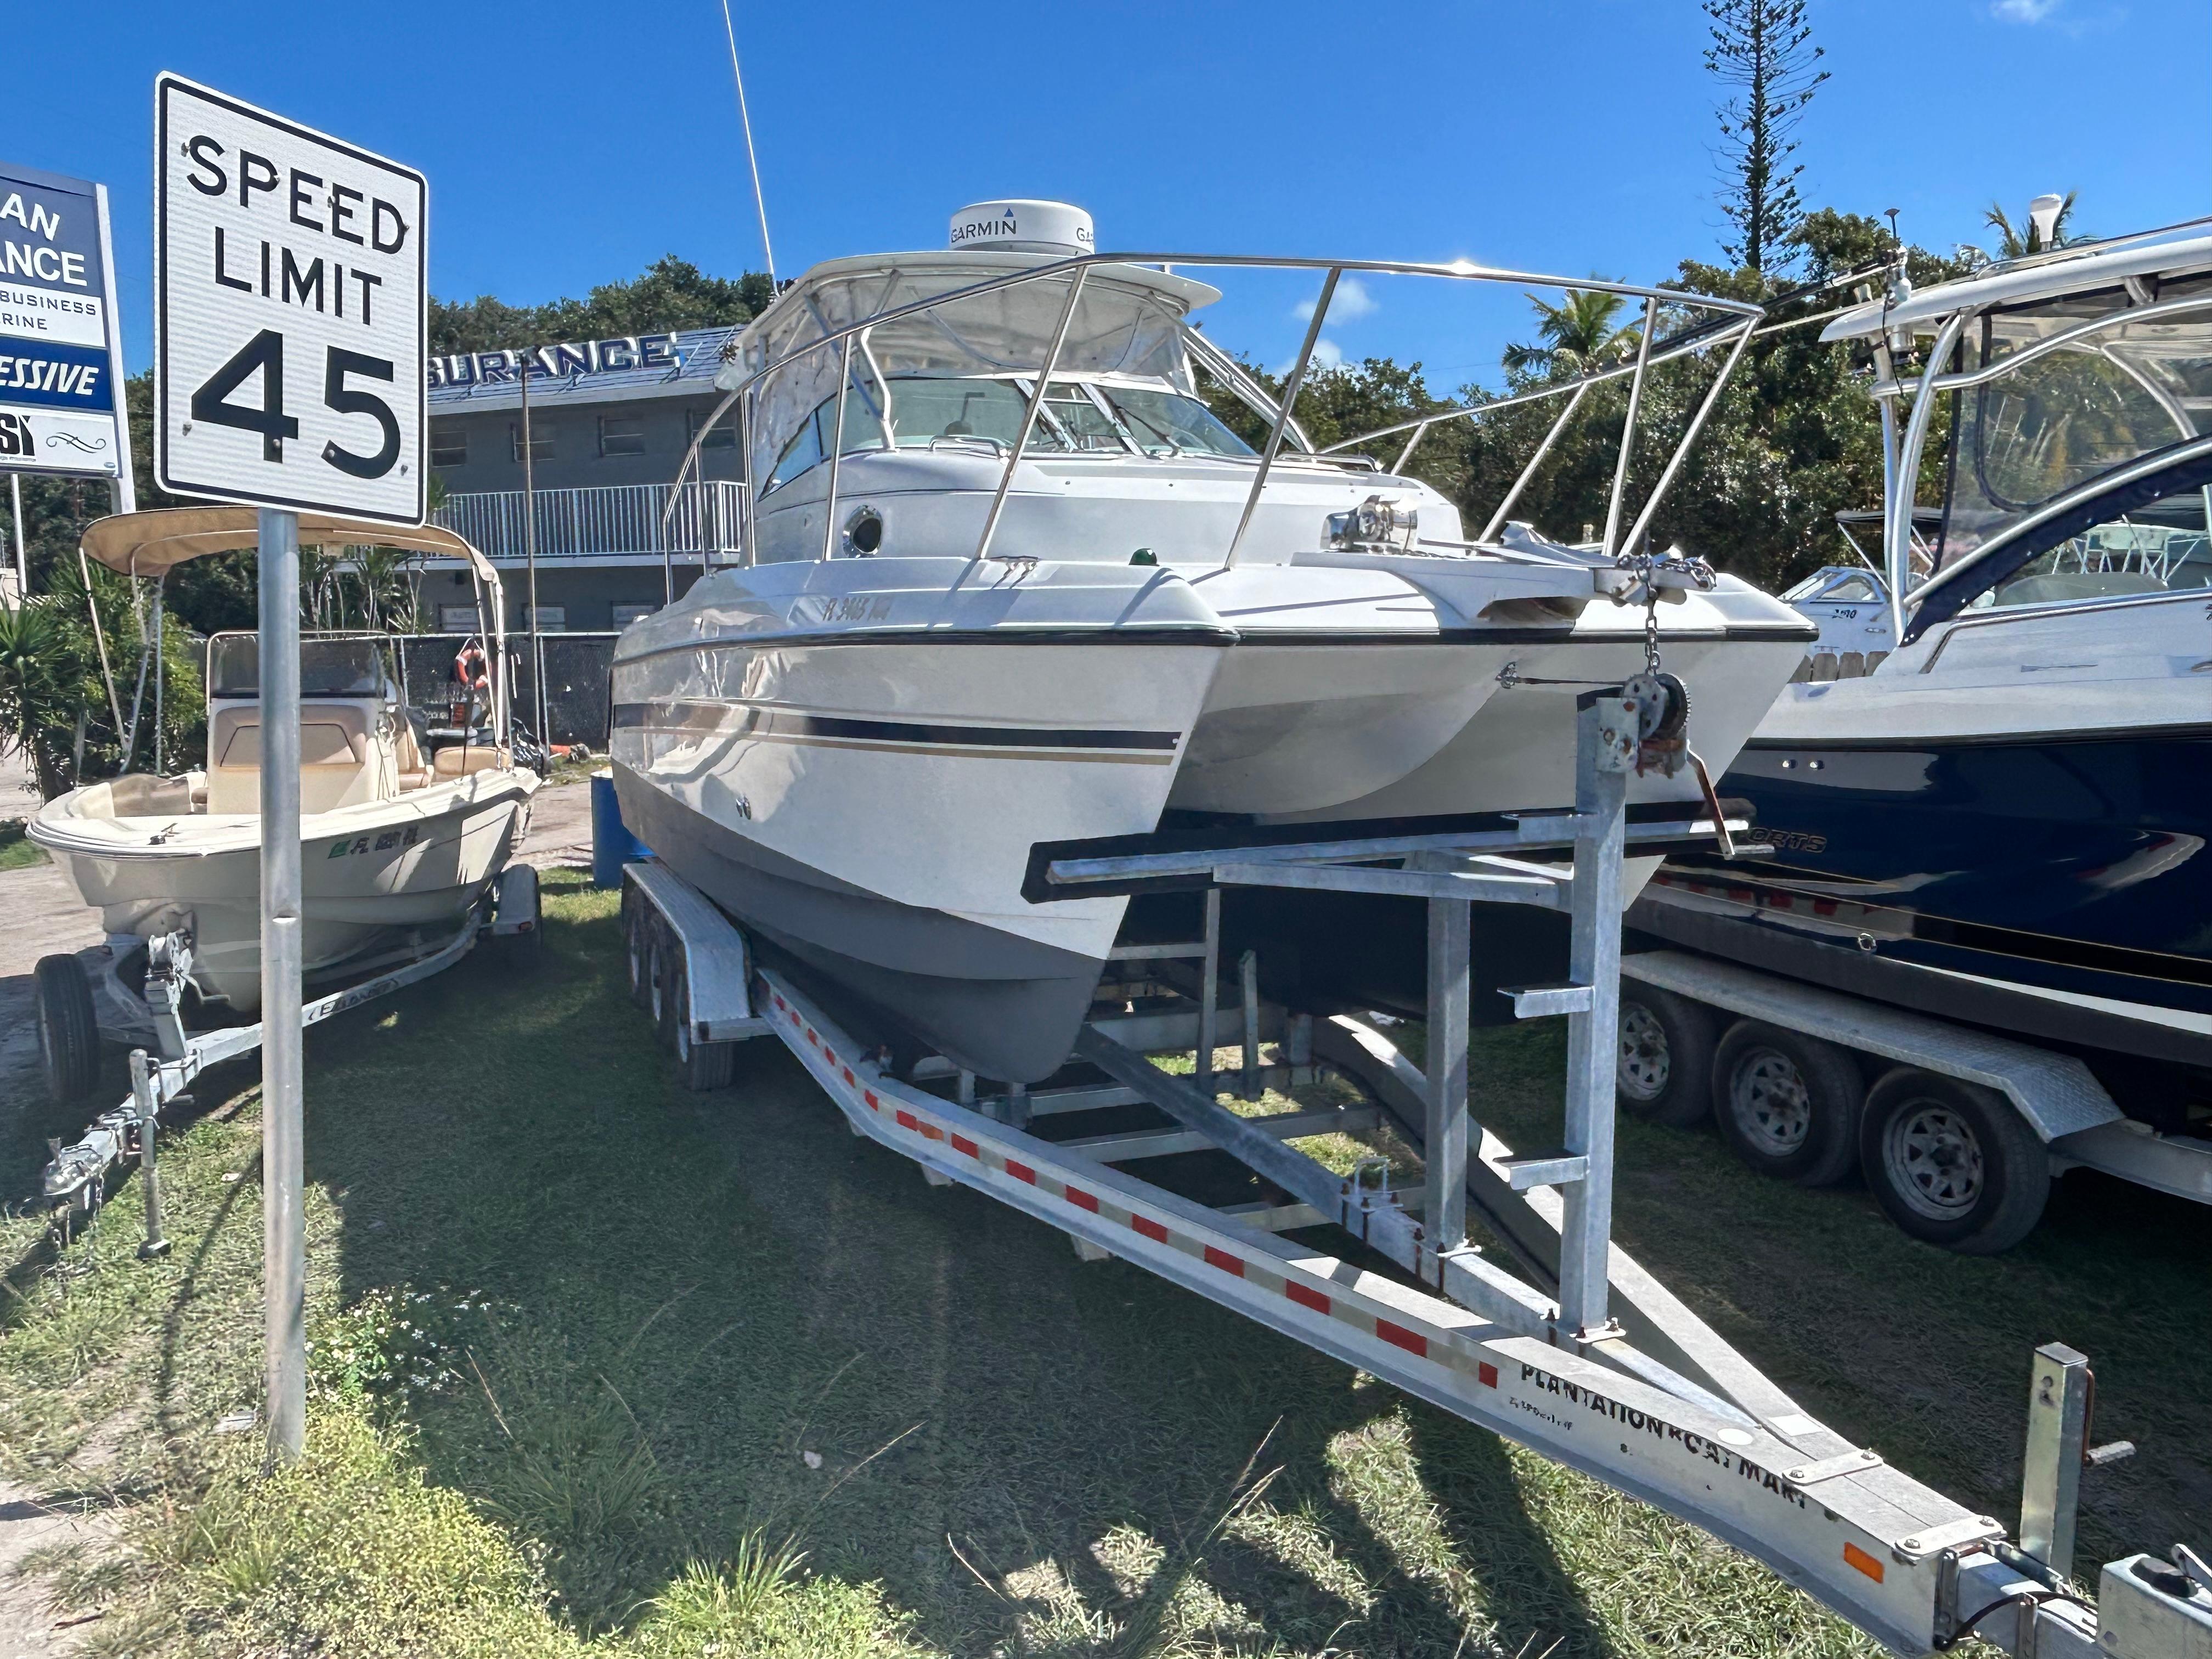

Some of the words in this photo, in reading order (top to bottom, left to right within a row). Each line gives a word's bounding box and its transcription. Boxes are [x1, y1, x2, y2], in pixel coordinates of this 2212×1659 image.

[0, 193, 60, 241] AN
[187, 135, 405, 254] SPEED
[951, 220, 1017, 243] GARMIN
[0, 240, 87, 286] NCE
[216, 227, 382, 326] LIMIT
[0, 290, 96, 315] BUSINESS
[0, 356, 99, 396] ESSIVE
[191, 329, 400, 479] 45
